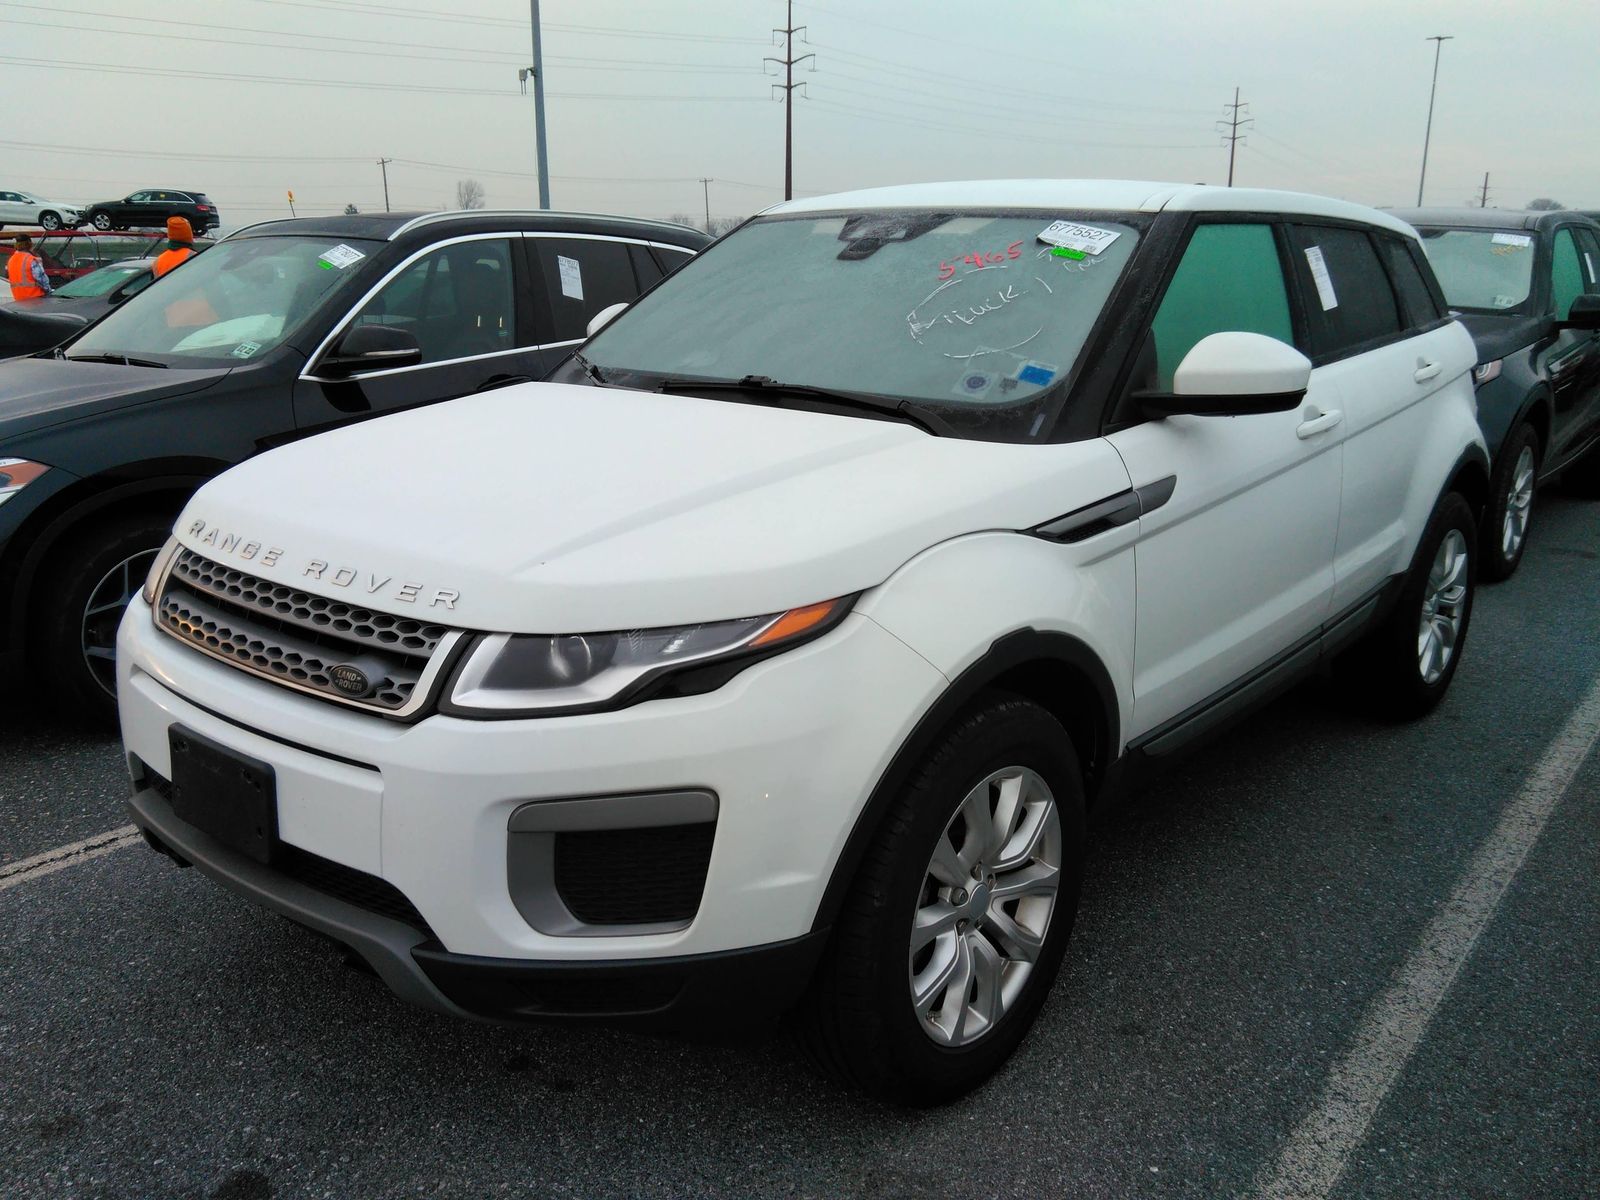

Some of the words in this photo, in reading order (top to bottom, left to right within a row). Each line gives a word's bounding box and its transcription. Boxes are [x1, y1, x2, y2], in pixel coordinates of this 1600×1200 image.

[1049, 223, 1111, 241] 6775527
[188, 519, 284, 567] RANGE
[302, 558, 460, 609] ROVER
[337, 669, 357, 681] LAND
[338, 679, 362, 690] ROVER
